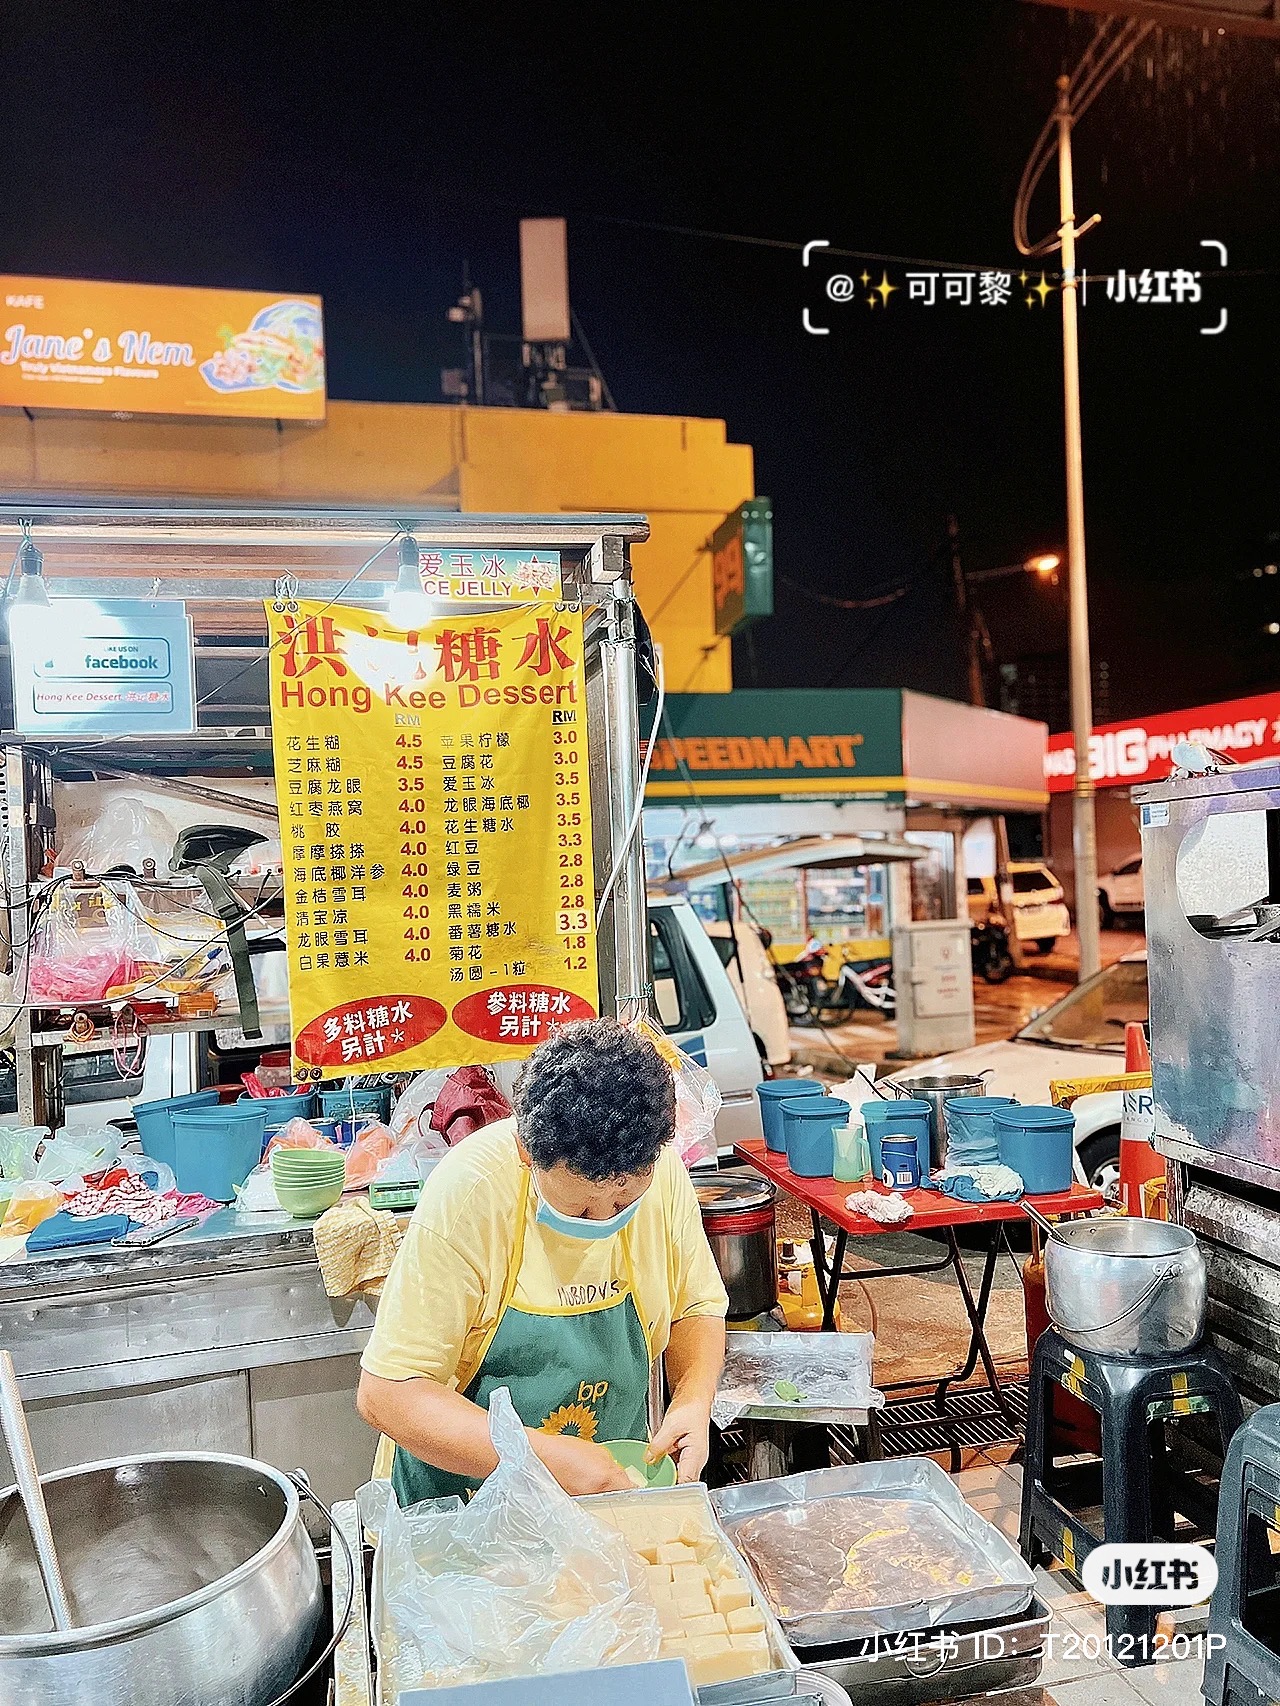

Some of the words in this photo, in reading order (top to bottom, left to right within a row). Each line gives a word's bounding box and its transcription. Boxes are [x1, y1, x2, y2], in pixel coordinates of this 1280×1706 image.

[1, 324, 113, 365] Jane's
[118, 330, 196, 366] Nem
[419, 553, 506, 578] 爱玉冰
[424, 581, 450, 595] CE
[456, 581, 513, 596] JELLY
[85, 655, 159, 669] facebook
[37, 692, 62, 702] Hong
[66, 693, 85, 701] Kee
[87, 693, 122, 701] Dessert
[281, 682, 371, 713] Hong
[385, 683, 446, 708] Kee
[458, 679, 578, 708] Dessert
[395, 714, 421, 726] RM
[552, 710, 577, 724] RM
[286, 735, 340, 751] 花生糊
[395, 734, 423, 748] 4.5
[553, 731, 577, 745] 3.0
[650, 735, 858, 770] SPEEDMART
[1087, 727, 1150, 779] BIG
[287, 757, 342, 774] 芝麻糊
[396, 756, 424, 770] 4.5
[442, 754, 494, 770] 豆腐花
[554, 751, 578, 765] 3.0
[289, 778, 362, 796] 豆腐龙眼
[398, 778, 425, 792] 3.5
[443, 776, 495, 792] 爱玉冰
[555, 772, 579, 786] 3.5
[289, 800, 363, 817] 红枣燕窝
[398, 799, 426, 813] 4.0
[444, 795, 530, 814] 龙眼海底椰
[556, 792, 580, 806] 3.5
[399, 820, 427, 835] 4.0
[444, 817, 515, 835] 花生糖水
[557, 813, 581, 827] 3.5
[400, 842, 427, 856] 4.0
[445, 840, 479, 856] 红豆
[558, 833, 582, 847] 3.3
[294, 863, 385, 883] 海底椰洋参
[401, 863, 428, 877] 4.0
[446, 860, 481, 877] 绿豆
[559, 854, 583, 867] 2.8
[295, 886, 367, 905] 金桔雪耳
[402, 884, 429, 898] 4.0
[447, 881, 482, 898] 麦粥
[560, 874, 584, 888] 2.8
[296, 909, 348, 927] 清宝凉
[403, 905, 430, 919] 4.0
[448, 901, 500, 919] 黑糯米
[561, 895, 585, 909] 2.8
[297, 929, 369, 949] 龙眼雪耳
[403, 926, 431, 941] 4.0
[448, 921, 517, 940] 番薯糖水
[559, 912, 588, 930] 3.3
[299, 951, 370, 970] 白果薏米
[404, 948, 431, 962] 4.0
[449, 945, 483, 961] 菊花
[563, 936, 586, 950] 1.8
[564, 956, 587, 970] 1.2
[322, 1000, 414, 1044] 多料糖水
[498, 1014, 541, 1037] 另計
[341, 1030, 386, 1062] 另計
[577, 1381, 609, 1403] bp
